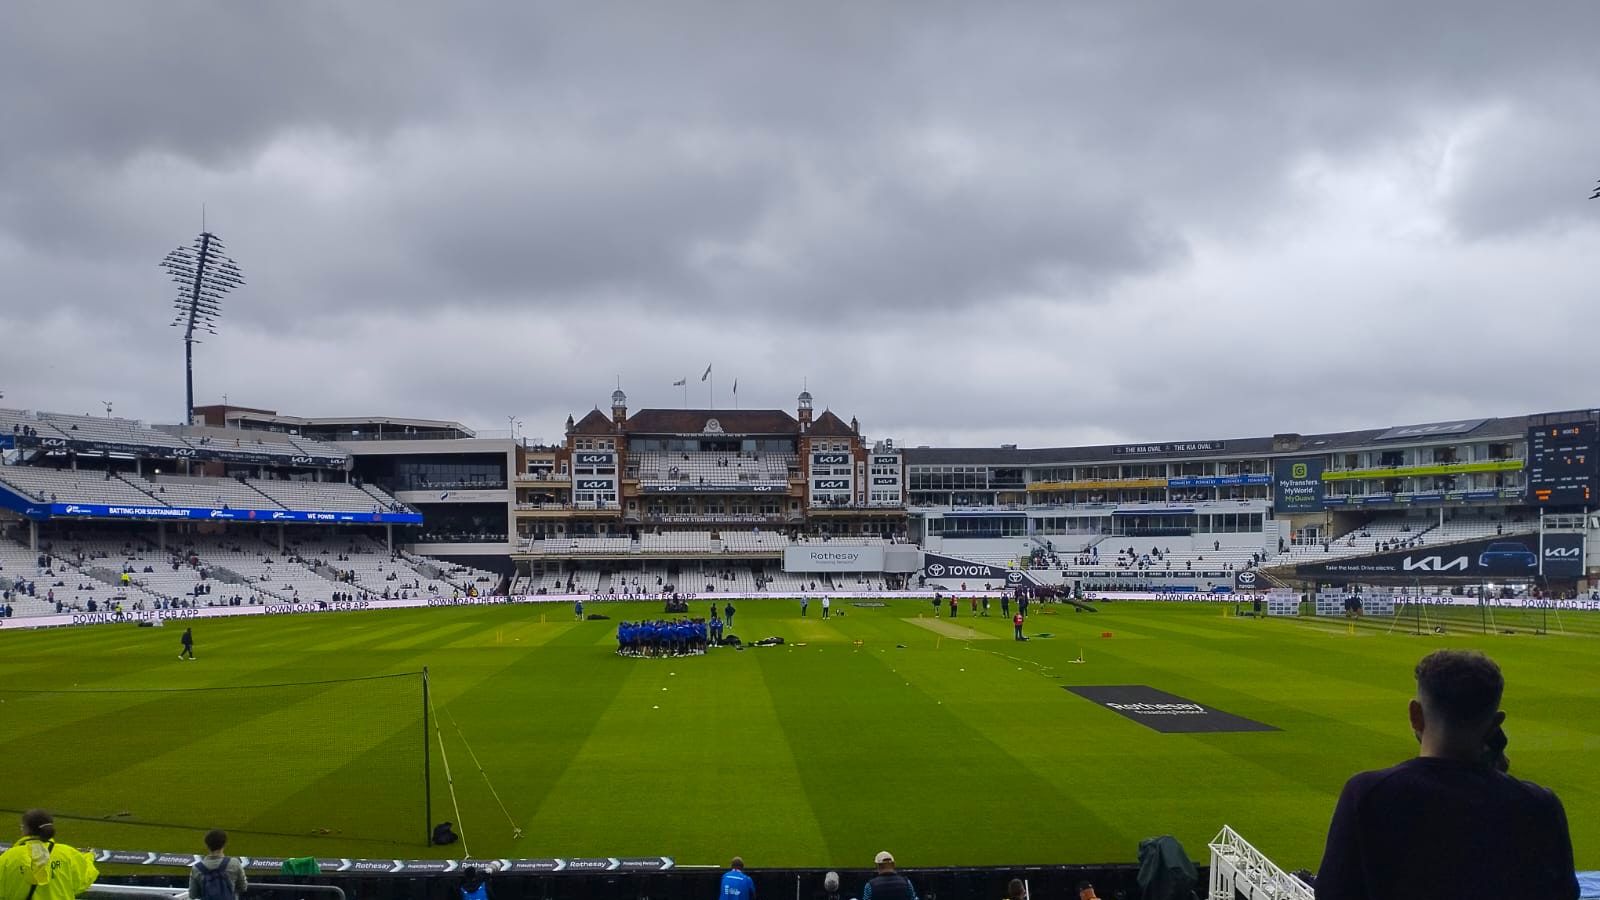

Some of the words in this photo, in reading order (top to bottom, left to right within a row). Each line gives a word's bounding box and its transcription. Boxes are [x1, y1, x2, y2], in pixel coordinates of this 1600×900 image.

[820, 456, 844, 464] KIA
[810, 552, 859, 560] Rothesay
[1545, 547, 1579, 557] KIA
[1402, 556, 1469, 571] KIA
[948, 566, 992, 576] TOYOTA
[264, 604, 316, 614] DOWNLOAD
[336, 602, 352, 610] ECB
[354, 602, 370, 610] APP
[1581, 602, 1600, 610] THE
[73, 612, 134, 624] DOWNLOAD
[137, 612, 156, 620] THE
[158, 611, 180, 620] ECB
[182, 610, 199, 618] APP
[1106, 702, 1204, 711] Rothesay
[158, 856, 191, 864] Rothesay
[355, 862, 391, 870] Rothesay
